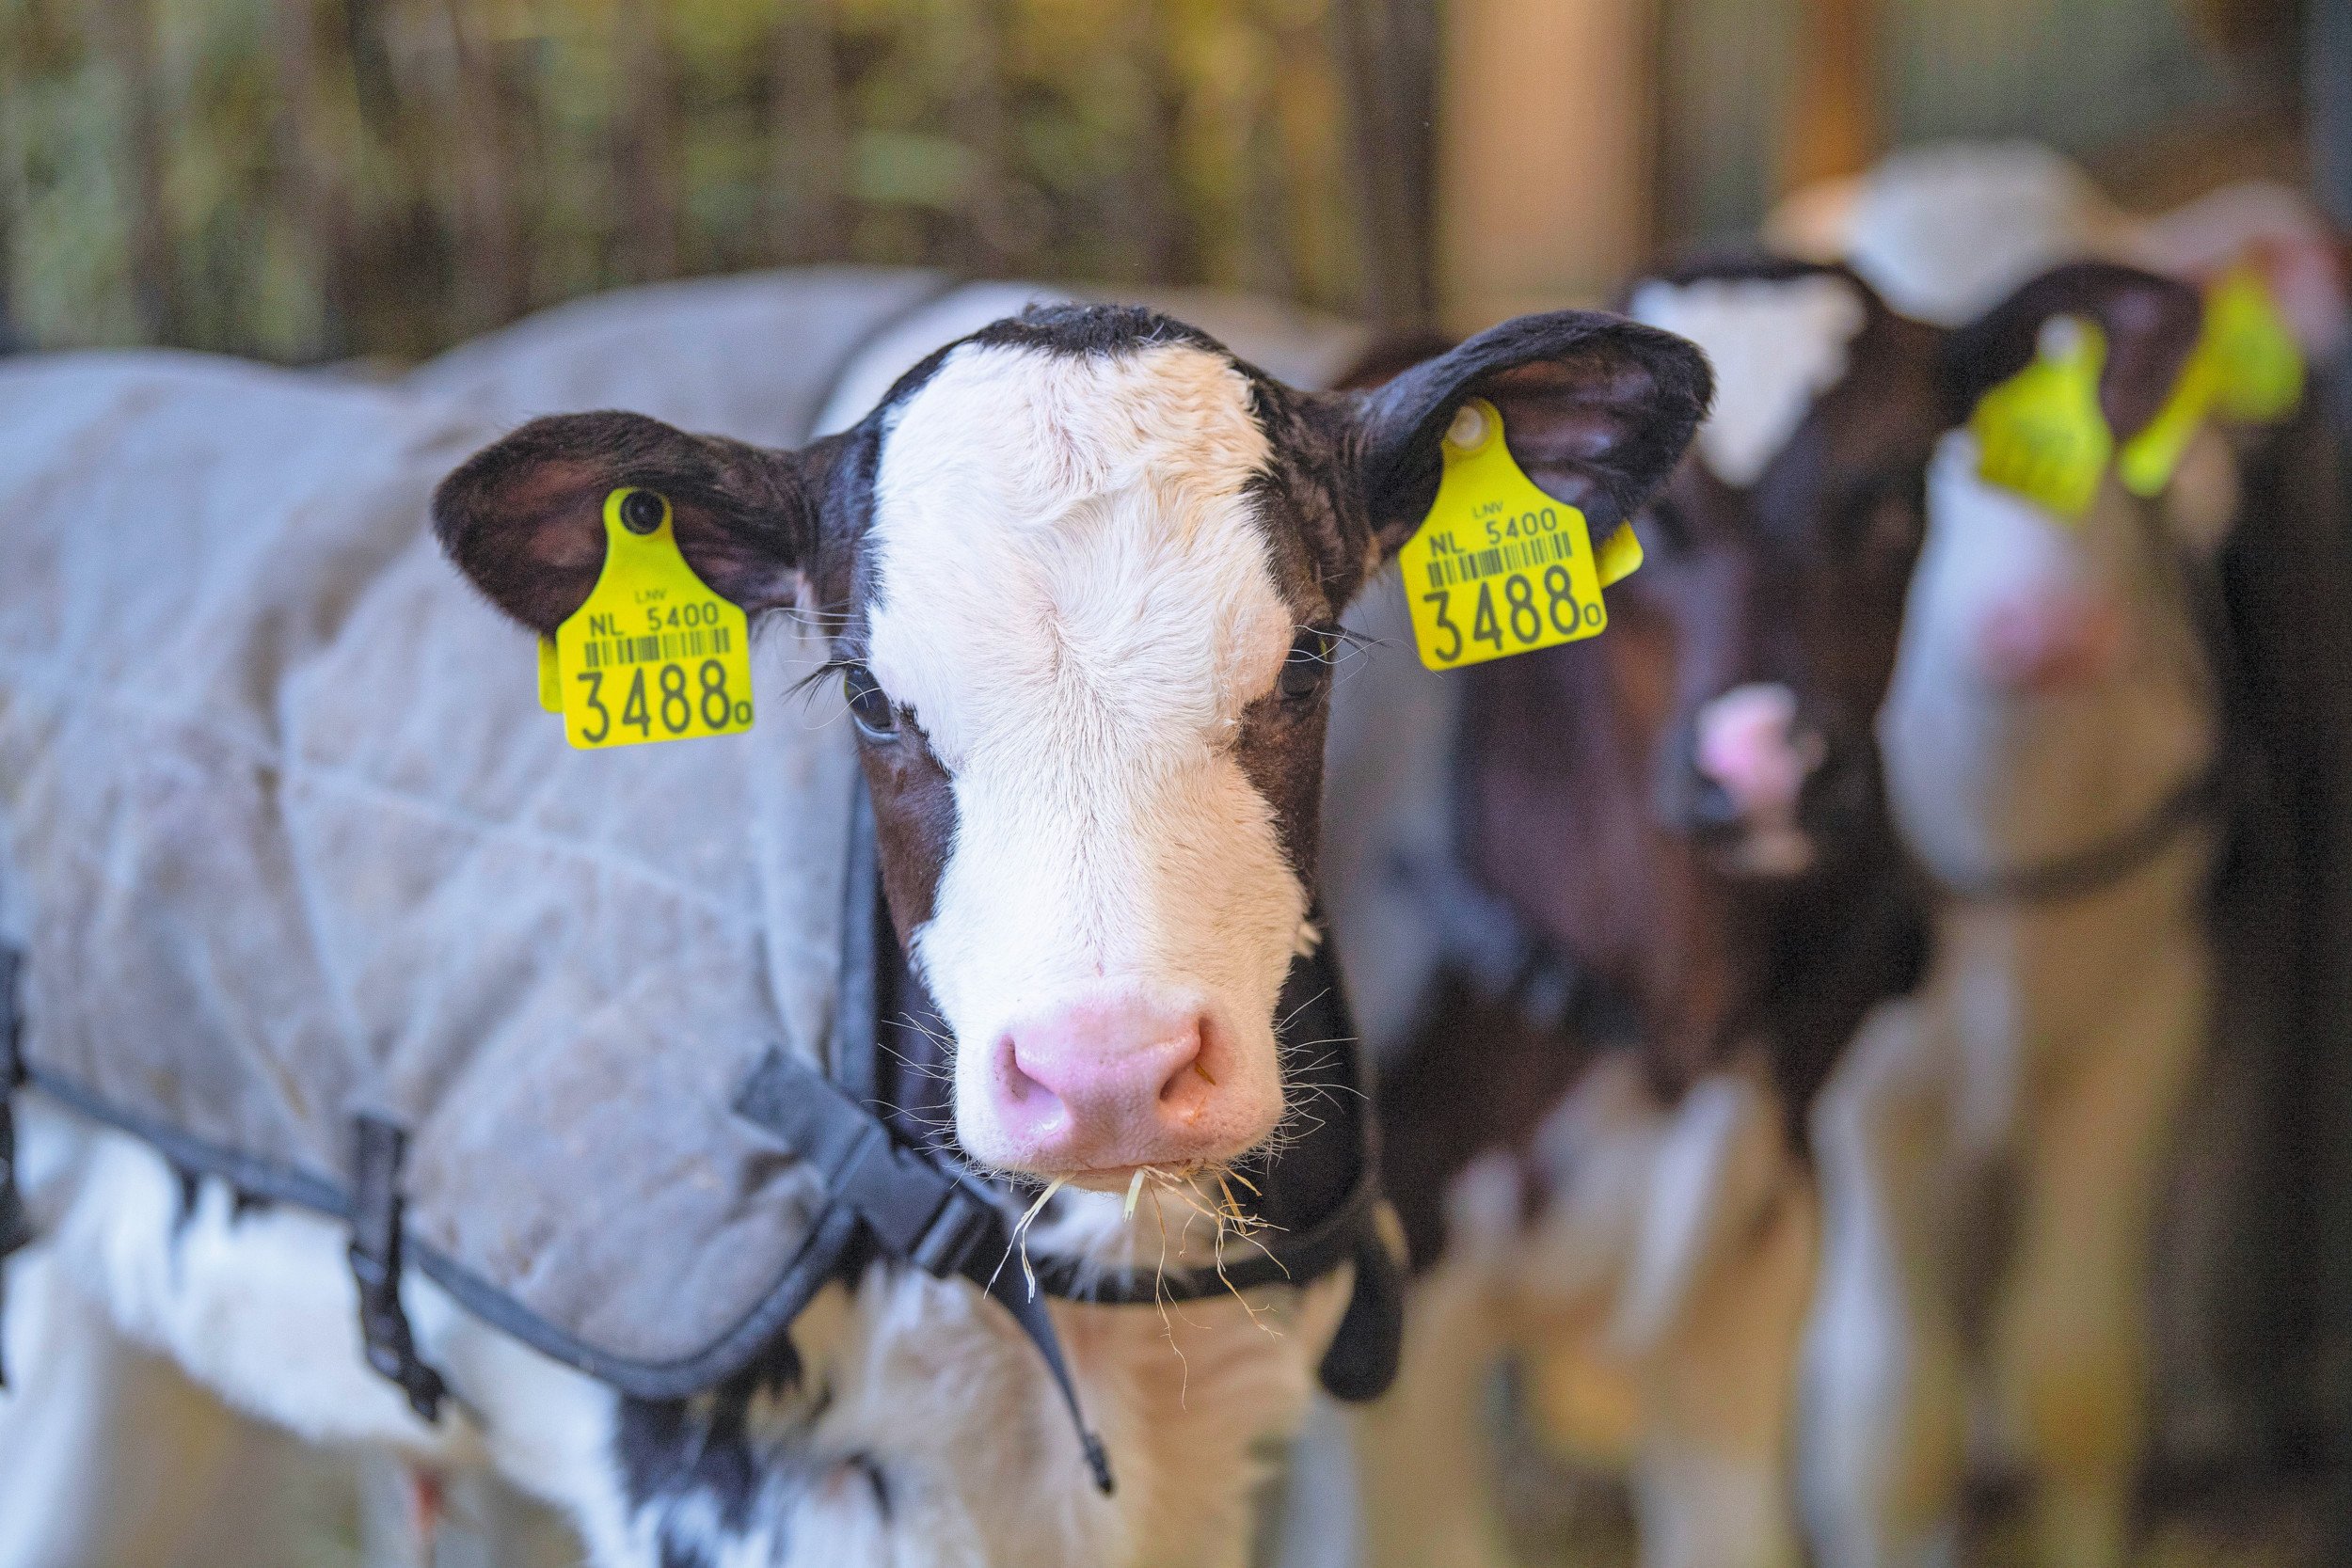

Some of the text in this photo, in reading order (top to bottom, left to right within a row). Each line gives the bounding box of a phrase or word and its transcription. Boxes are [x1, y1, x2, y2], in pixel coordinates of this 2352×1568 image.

[1472, 500, 1503, 517] LNV
[1428, 508, 1557, 557] NL 5400
[634, 589, 667, 604] LNV
[589, 601, 719, 637] NL 5400
